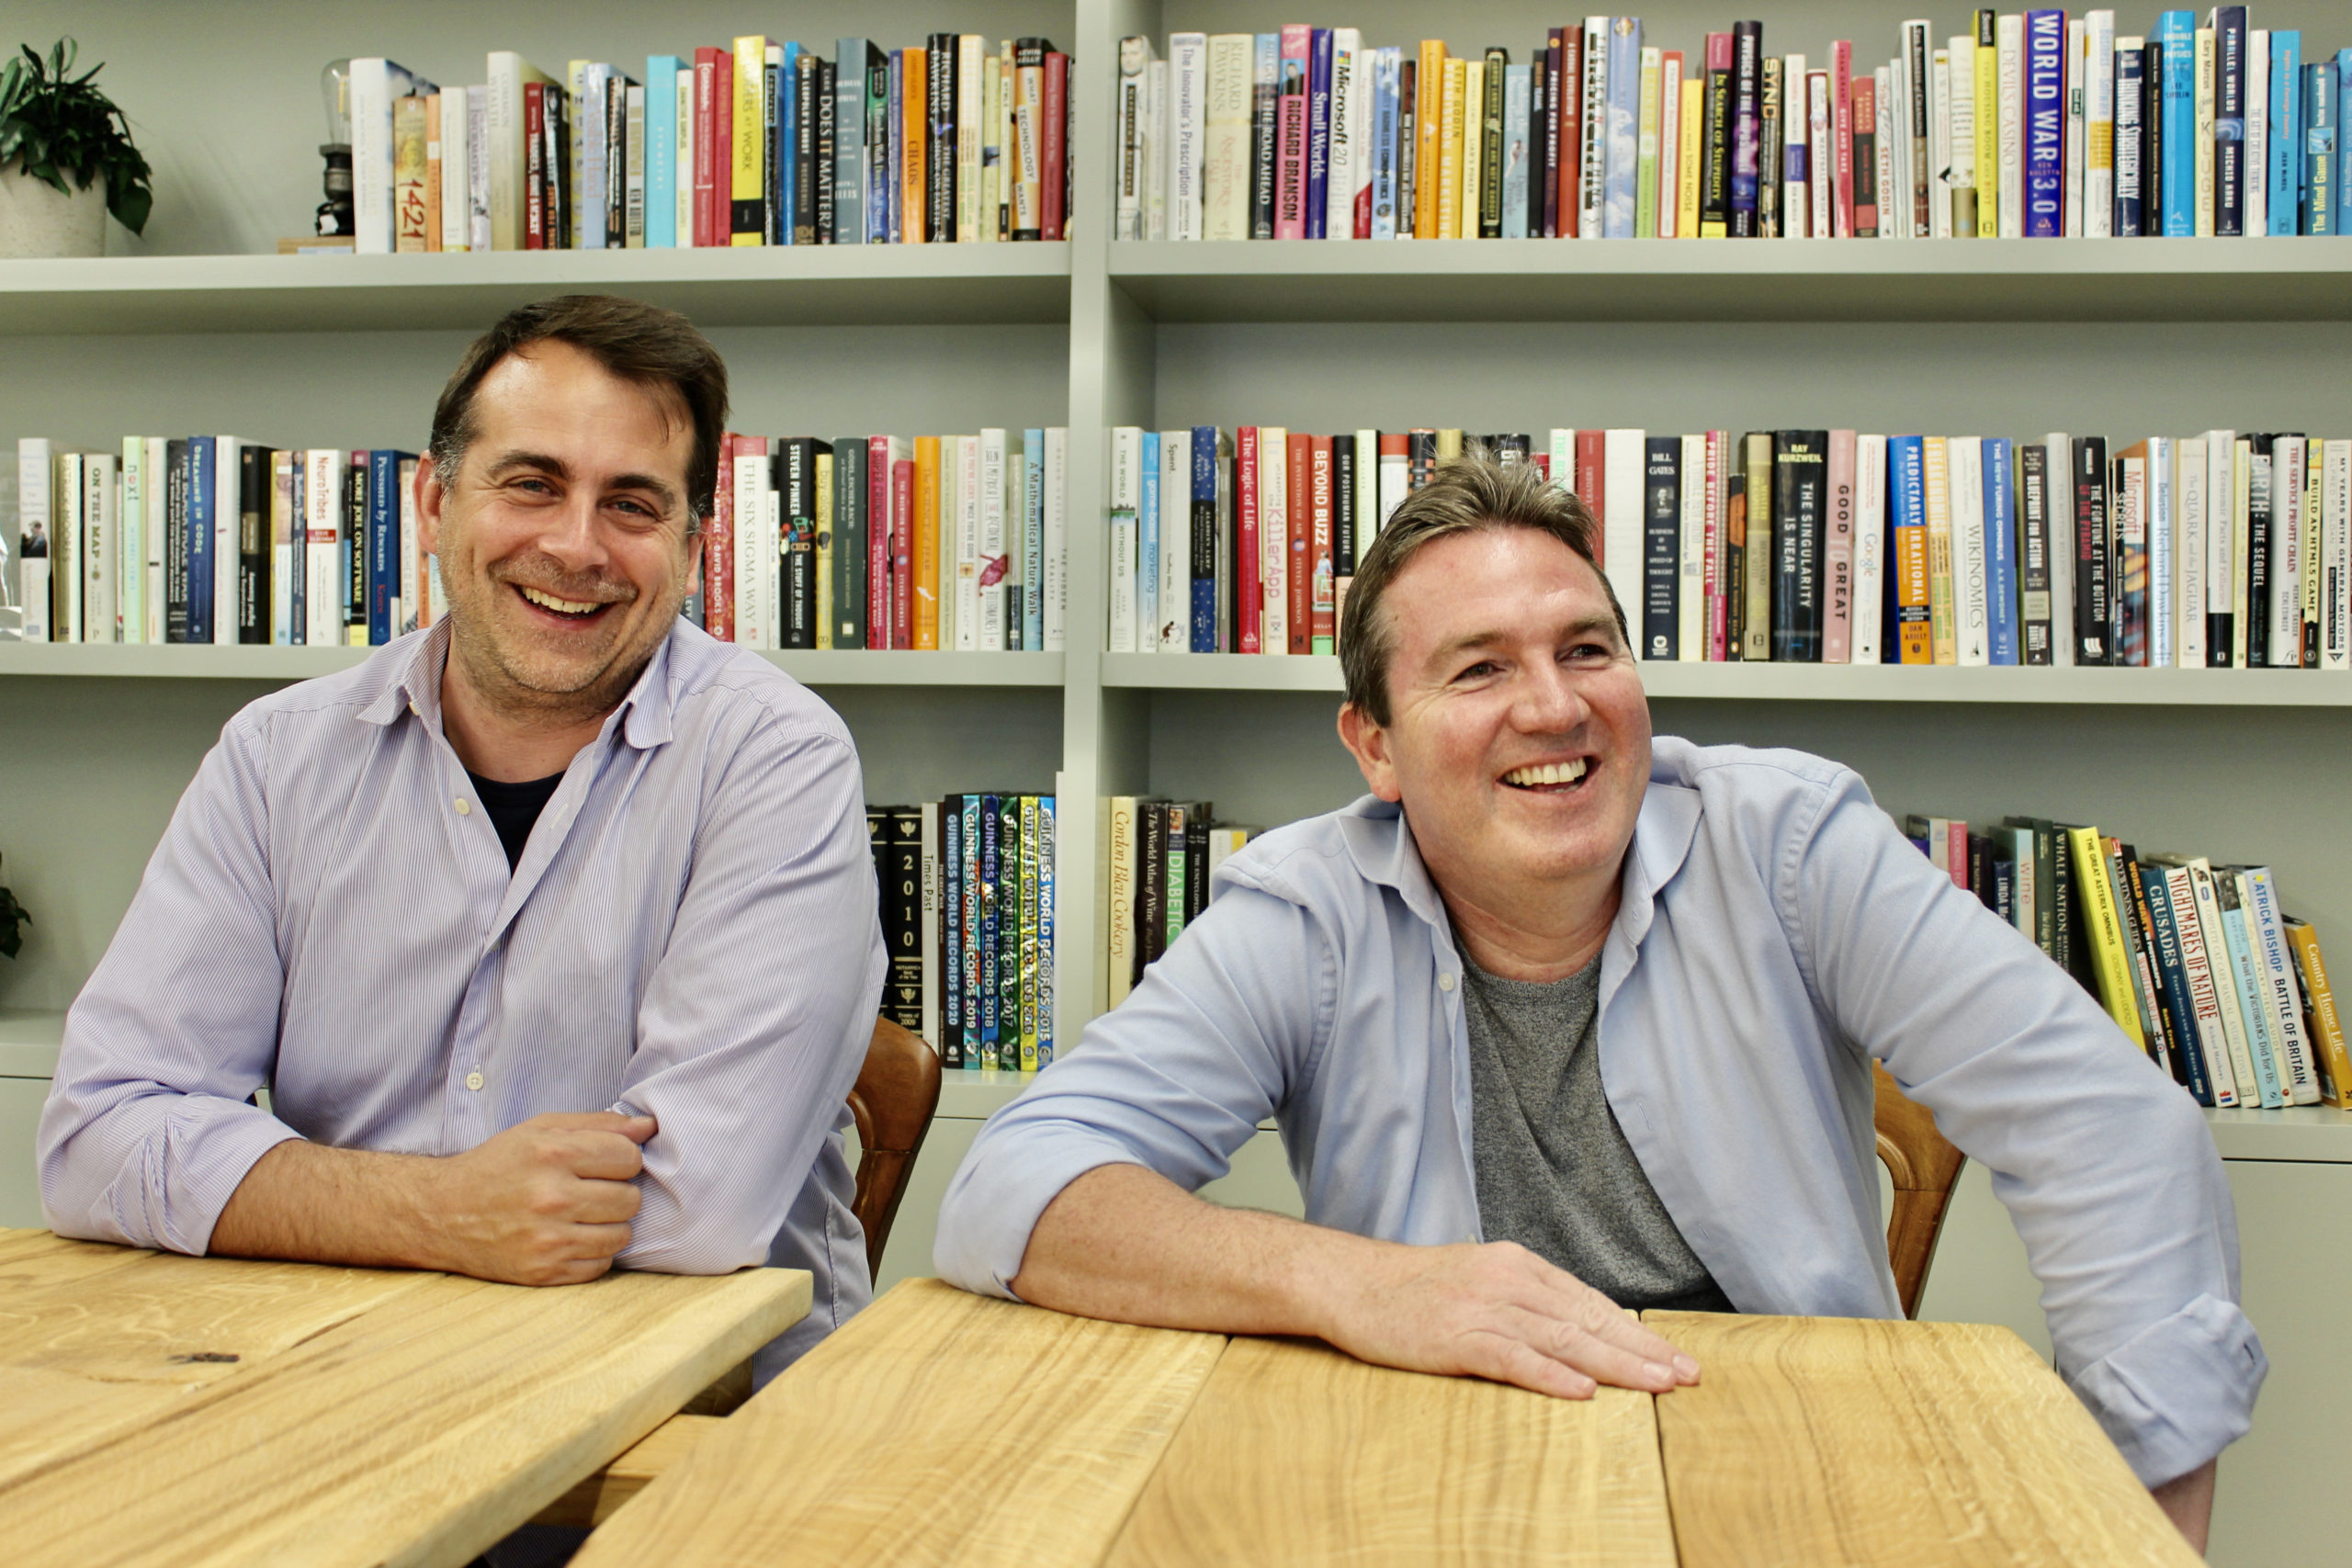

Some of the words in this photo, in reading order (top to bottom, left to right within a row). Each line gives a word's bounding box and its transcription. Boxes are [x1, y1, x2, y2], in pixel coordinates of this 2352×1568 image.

[1182, 49, 1193, 65] The
[2033, 15, 2058, 99] WORLD
[2227, 28, 2235, 72] PARALLEL
[1027, 76, 1036, 103] WHAT
[1181, 70, 1193, 129] Innovator's
[1334, 66, 1350, 144] Microsoft
[1442, 64, 1453, 149] PERMISSION
[1763, 58, 1778, 118] SYNC
[2118, 77, 2141, 125] THINKING
[2226, 75, 2234, 111] WORLDS
[820, 96, 833, 136] DOES
[1262, 100, 1272, 123] THE
[1286, 100, 1301, 155] RICHARD
[1314, 92, 1326, 130] Small
[820, 140, 833, 156] IT
[1018, 109, 1035, 179] TECHNOLOGY
[1261, 128, 1272, 160] ROAD
[1311, 132, 1325, 178] Worlds
[2033, 109, 2058, 161] WAR
[908, 141, 919, 185] CHAOS
[1179, 131, 1191, 196] Prescription
[2118, 127, 2141, 199] STRATEGICALLY
[819, 160, 831, 228] MATTER?
[1016, 184, 1026, 216] WANTS
[1260, 164, 1271, 205] AHEAD
[1283, 161, 1299, 221] BRANSON
[1440, 156, 1451, 240] MARKETING
[2033, 177, 2057, 213] 3.0
[399, 179, 425, 239] 1421
[790, 445, 800, 479] STEVEN
[1243, 435, 1253, 457] The
[2339, 458, 2346, 474] MY
[93, 468, 101, 488] ON
[316, 457, 329, 520] NeuroTribes
[355, 472, 363, 502] MORE
[744, 461, 755, 496] THE
[1241, 461, 1254, 491] Logic
[1315, 450, 1328, 504] BEYOND
[1802, 483, 1813, 509] THE
[1906, 446, 1920, 524] PREDICTABLY
[2080, 485, 2089, 495] OF
[2091, 485, 2102, 501] THE
[2250, 454, 2270, 517] EARTH:
[355, 506, 363, 528] JOEL
[745, 501, 755, 526] SIX
[790, 481, 799, 515] PINKER
[1029, 474, 1037, 547] Mathematical
[1244, 494, 1254, 505] of
[1342, 474, 1351, 521] POSTHUMAN
[1838, 485, 1849, 534] GOOD
[2080, 501, 2090, 516] THE
[355, 532, 362, 547] ON
[1244, 510, 1255, 530] Life
[1316, 509, 1328, 546] BUZZ
[1342, 525, 1351, 555] FUTURE
[1785, 518, 1794, 530] IS
[2081, 520, 2091, 560] PYRAMID
[2091, 505, 2103, 546] FORTUNE
[2255, 524, 2265, 542] THE
[2310, 517, 2318, 536] AN
[745, 531, 755, 585] SIGMA
[1028, 551, 1037, 587] Nature
[1784, 538, 1794, 572] NEAR
[1801, 514, 1812, 607] SINGULARITY
[1829, 538, 1849, 561] TO
[1909, 530, 1923, 602] IRRATIONAL
[2093, 549, 2103, 560] AT
[2253, 547, 2264, 587] SEQUEL
[354, 550, 362, 604] SOFTWARE
[1836, 562, 1847, 620] GREAT
[1968, 525, 1984, 628] WIKINOMICS
[2093, 565, 2103, 581] THE
[745, 589, 755, 623] WAY
[1028, 591, 1037, 615] Walk
[2094, 585, 2104, 621] BOTTOM
[1023, 806, 1035, 874] GUINNESS
[1114, 811, 1129, 861] Cordon
[1148, 812, 1157, 829] The
[947, 815, 957, 878] GUINNESS
[966, 814, 975, 879] GUINNESS
[984, 812, 994, 879] GUINNESS
[1003, 815, 1017, 879] GUINNESS
[1040, 808, 1051, 882] GUINNESS
[1148, 830, 1157, 859] World
[2056, 834, 2066, 877] WHALE
[2086, 838, 2094, 852] THE
[922, 855, 933, 886] Times
[1114, 865, 1127, 896] Bleu
[1147, 861, 1157, 885] Atlas
[2020, 862, 2033, 905] wine
[2088, 853, 2100, 877] GREAT
[923, 889, 933, 911] Past
[948, 882, 957, 927] WORLD
[966, 884, 976, 930] WORLD
[985, 883, 994, 931] WORLD
[1003, 886, 1013, 931] WORLD
[1023, 878, 1035, 930] WORLD
[1041, 885, 1051, 935] WORLD
[1147, 897, 1156, 922] Wine
[1168, 855, 1182, 936] DIABETIC
[2056, 885, 2066, 932] NATION
[2095, 879, 2108, 909] ASTERIX
[2167, 874, 2203, 953] NIGHTMARES
[2254, 874, 2271, 925] ATRICK
[1111, 899, 1127, 959] Cookery
[2102, 913, 2115, 945] OMNIBUS
[2149, 886, 2178, 967] CRUSADES
[948, 931, 957, 991] RECORDS
[966, 934, 976, 996] RECORDS
[984, 933, 994, 995] RECORDS
[1003, 936, 1013, 992] RECORDS
[1023, 934, 1034, 1001] RECORDS
[2187, 956, 2206, 970] OF
[2241, 955, 2252, 976] What
[2264, 930, 2282, 972] BISHOP
[1040, 939, 1050, 1006] RECORDS
[2245, 978, 2255, 992] the
[948, 996, 957, 1025] 2020
[966, 999, 976, 1028] 2019
[984, 998, 994, 1027] 2018
[1003, 998, 1014, 1027] 2017
[2191, 974, 2217, 1020] NATURE
[2274, 978, 2292, 1019] BATTLE
[2308, 943, 2326, 988] Country
[2320, 992, 2337, 1029] House
[2329, 1032, 2345, 1053] Life
[1023, 1006, 1034, 1034] 2016
[1040, 1010, 1050, 1041] 2015
[2284, 1023, 2298, 1036] OF
[2258, 1042, 2269, 1055] Did
[2261, 1059, 2271, 1070] for
[2288, 1041, 2306, 1084] BRITAIN
[2265, 1074, 2274, 1083] Us
